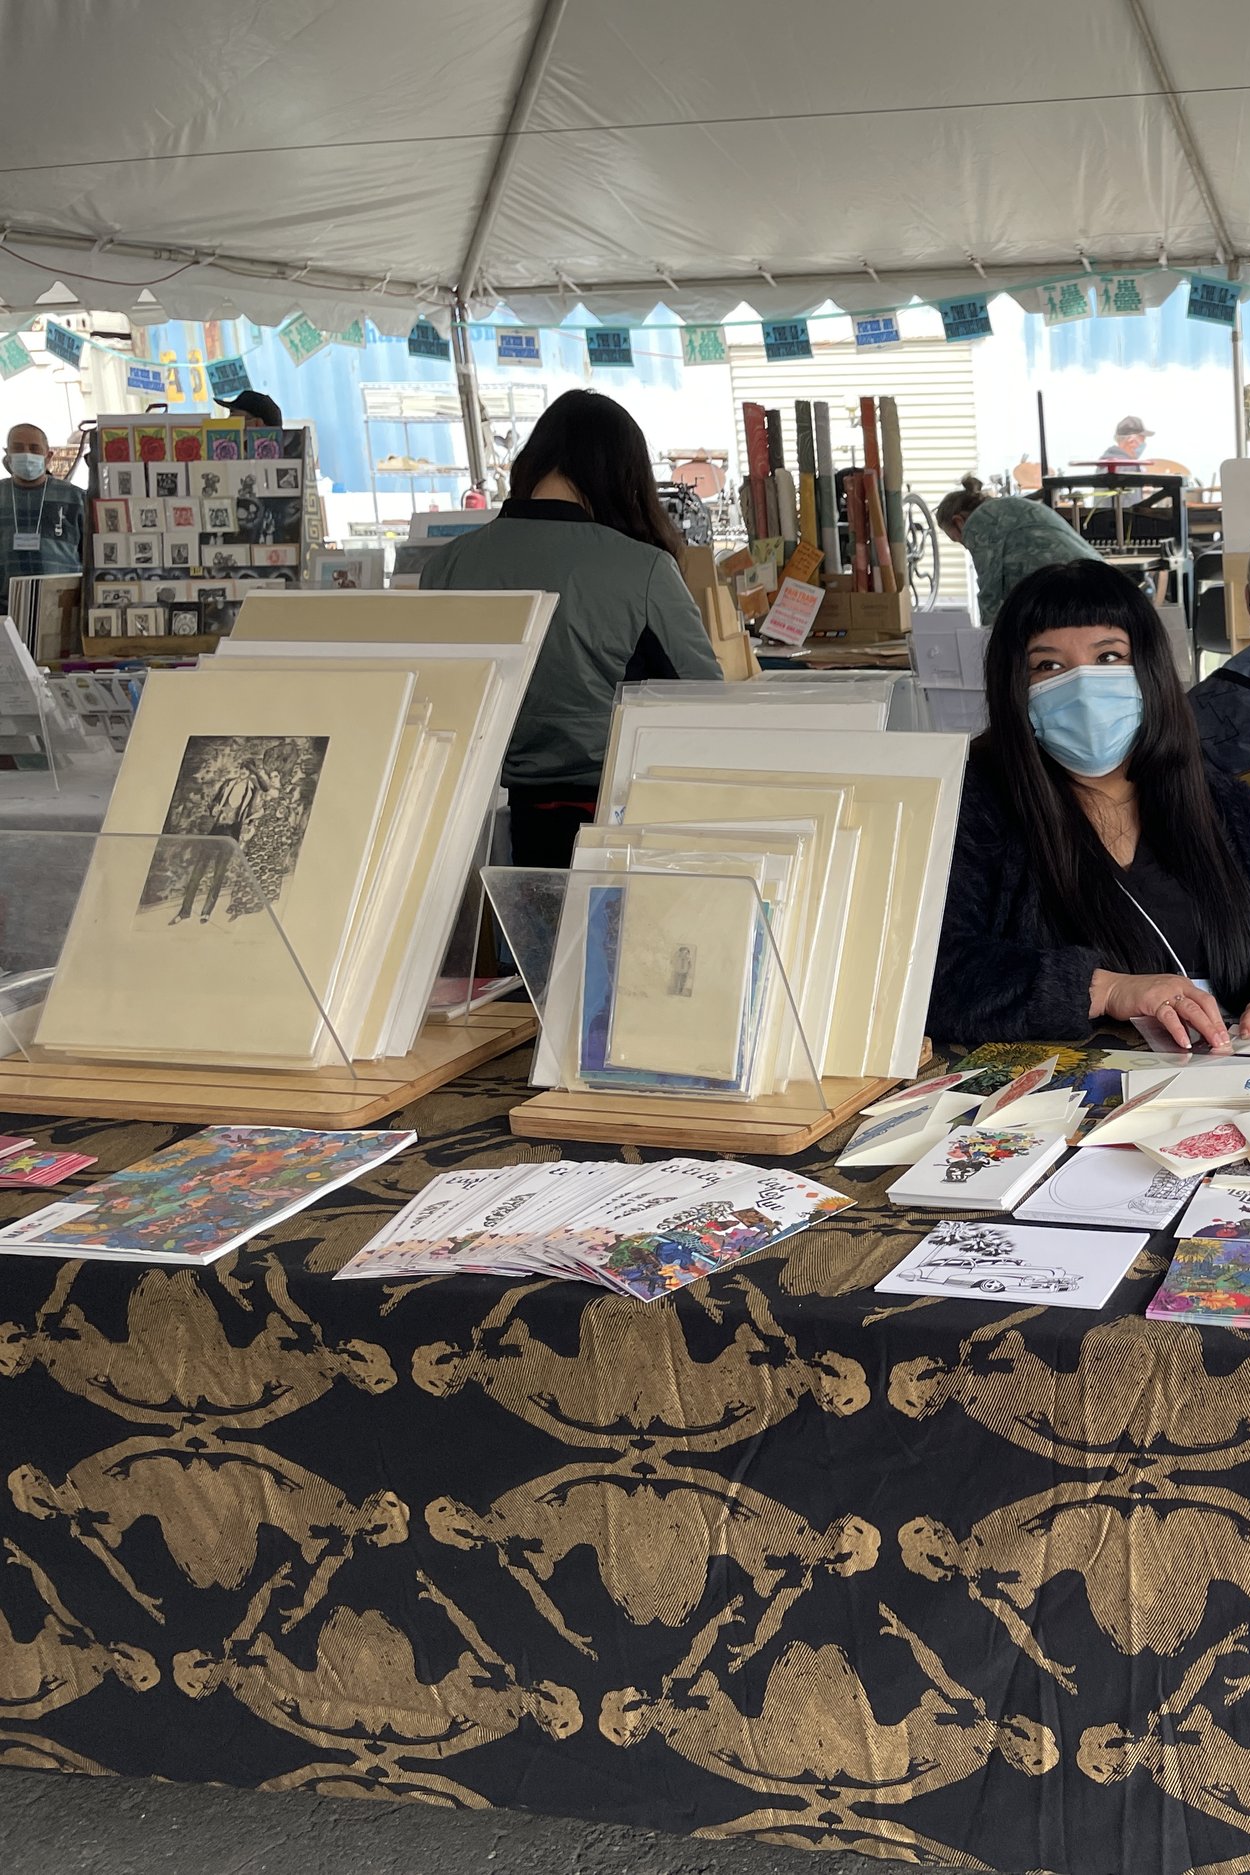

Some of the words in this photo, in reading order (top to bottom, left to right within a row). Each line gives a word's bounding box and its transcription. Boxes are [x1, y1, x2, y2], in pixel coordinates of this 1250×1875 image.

[757, 1177, 795, 1193] East
[758, 1189, 785, 1200] Los
[755, 1199, 786, 1212] Luv
